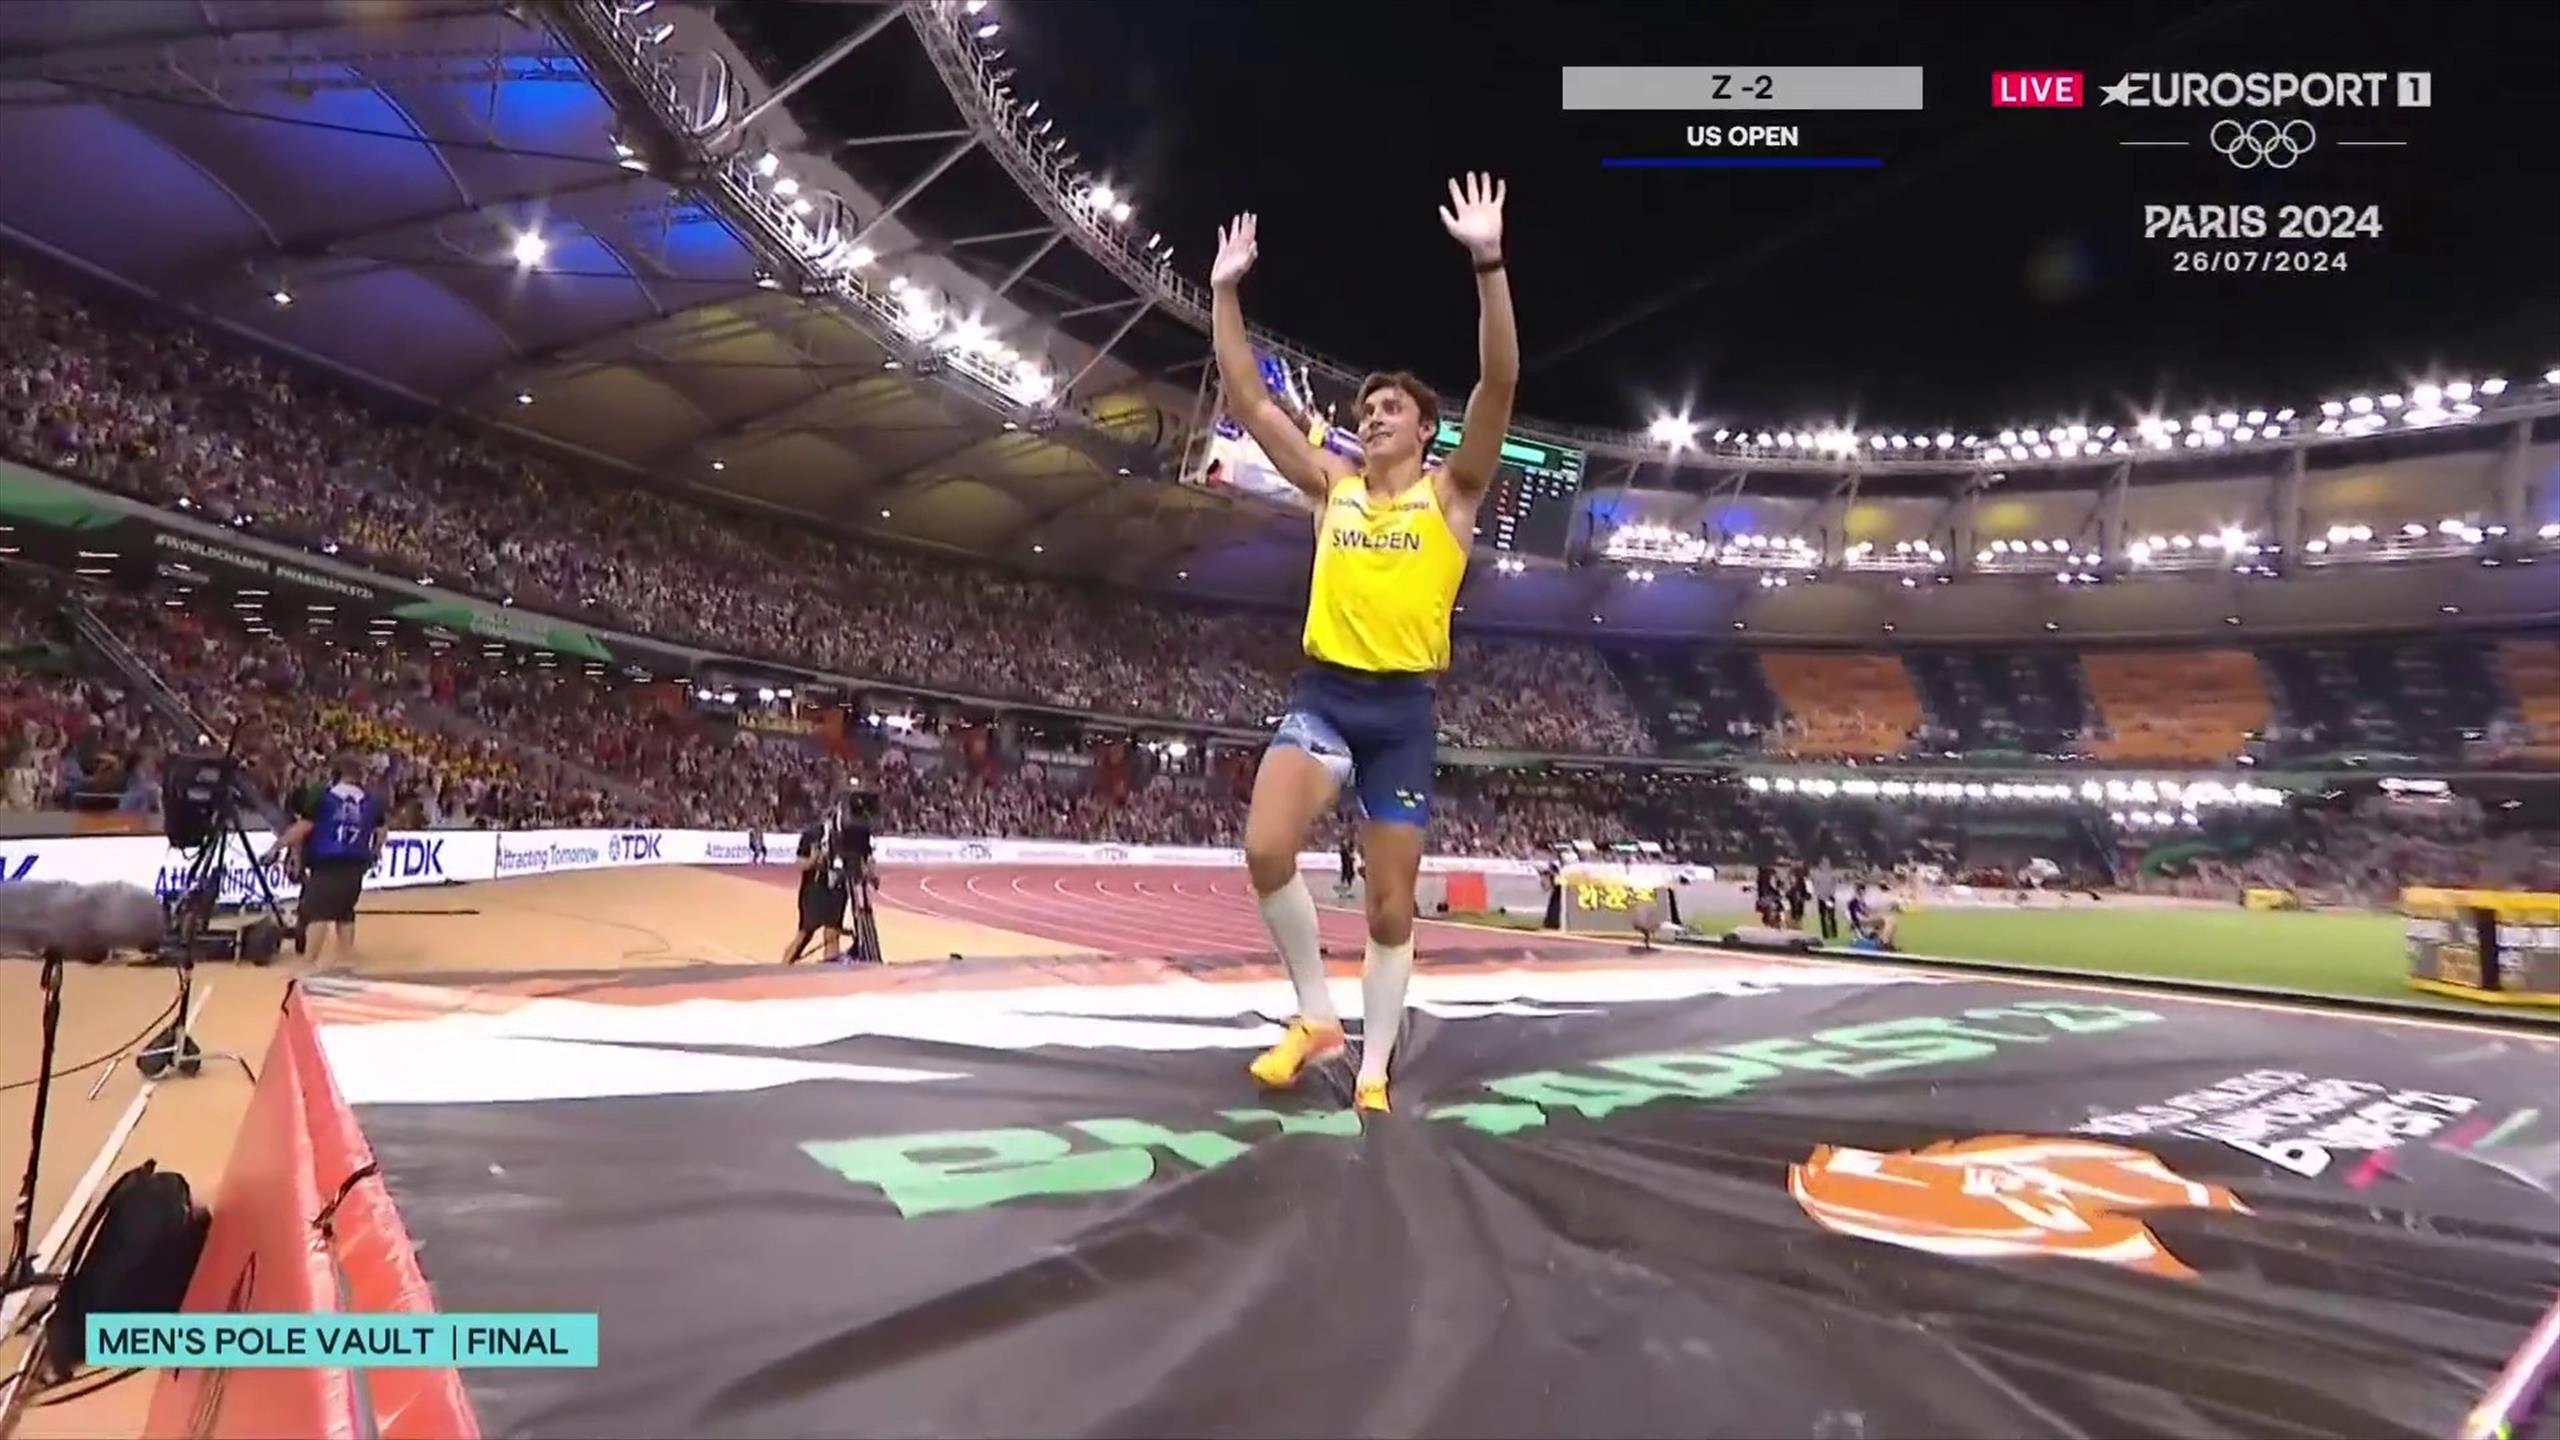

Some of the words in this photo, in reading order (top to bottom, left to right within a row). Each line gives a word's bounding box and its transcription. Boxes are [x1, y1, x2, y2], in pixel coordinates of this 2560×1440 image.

[1331, 528, 1421, 551] SWEDEN
[336, 825, 360, 844] 17
[620, 832, 662, 861] TDK
[386, 838, 444, 878] TDK
